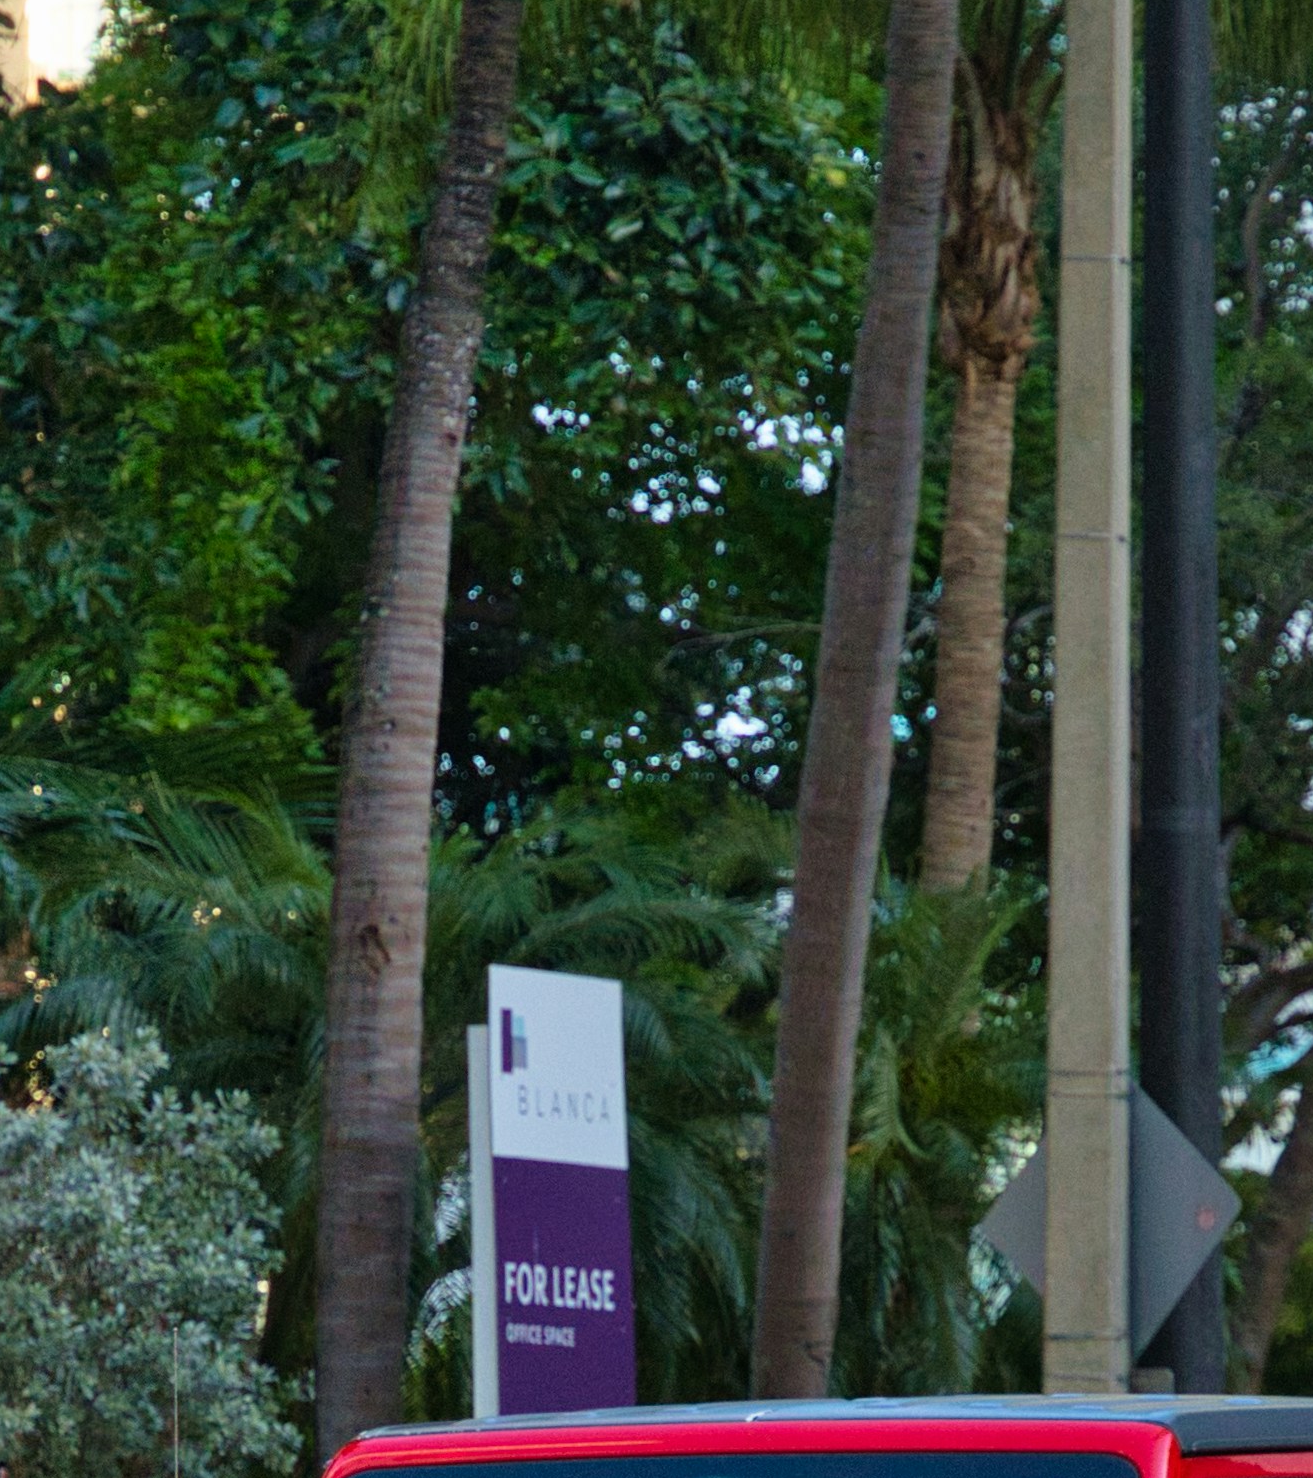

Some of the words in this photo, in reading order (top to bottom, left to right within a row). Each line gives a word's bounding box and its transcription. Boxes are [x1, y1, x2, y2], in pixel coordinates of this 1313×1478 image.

[517, 1084, 610, 1123] BLANCA
[505, 1261, 549, 1307] FOR
[552, 1266, 616, 1312] LEASE
[506, 1322, 542, 1345] OFFICE
[544, 1325, 575, 1348] SPACE
